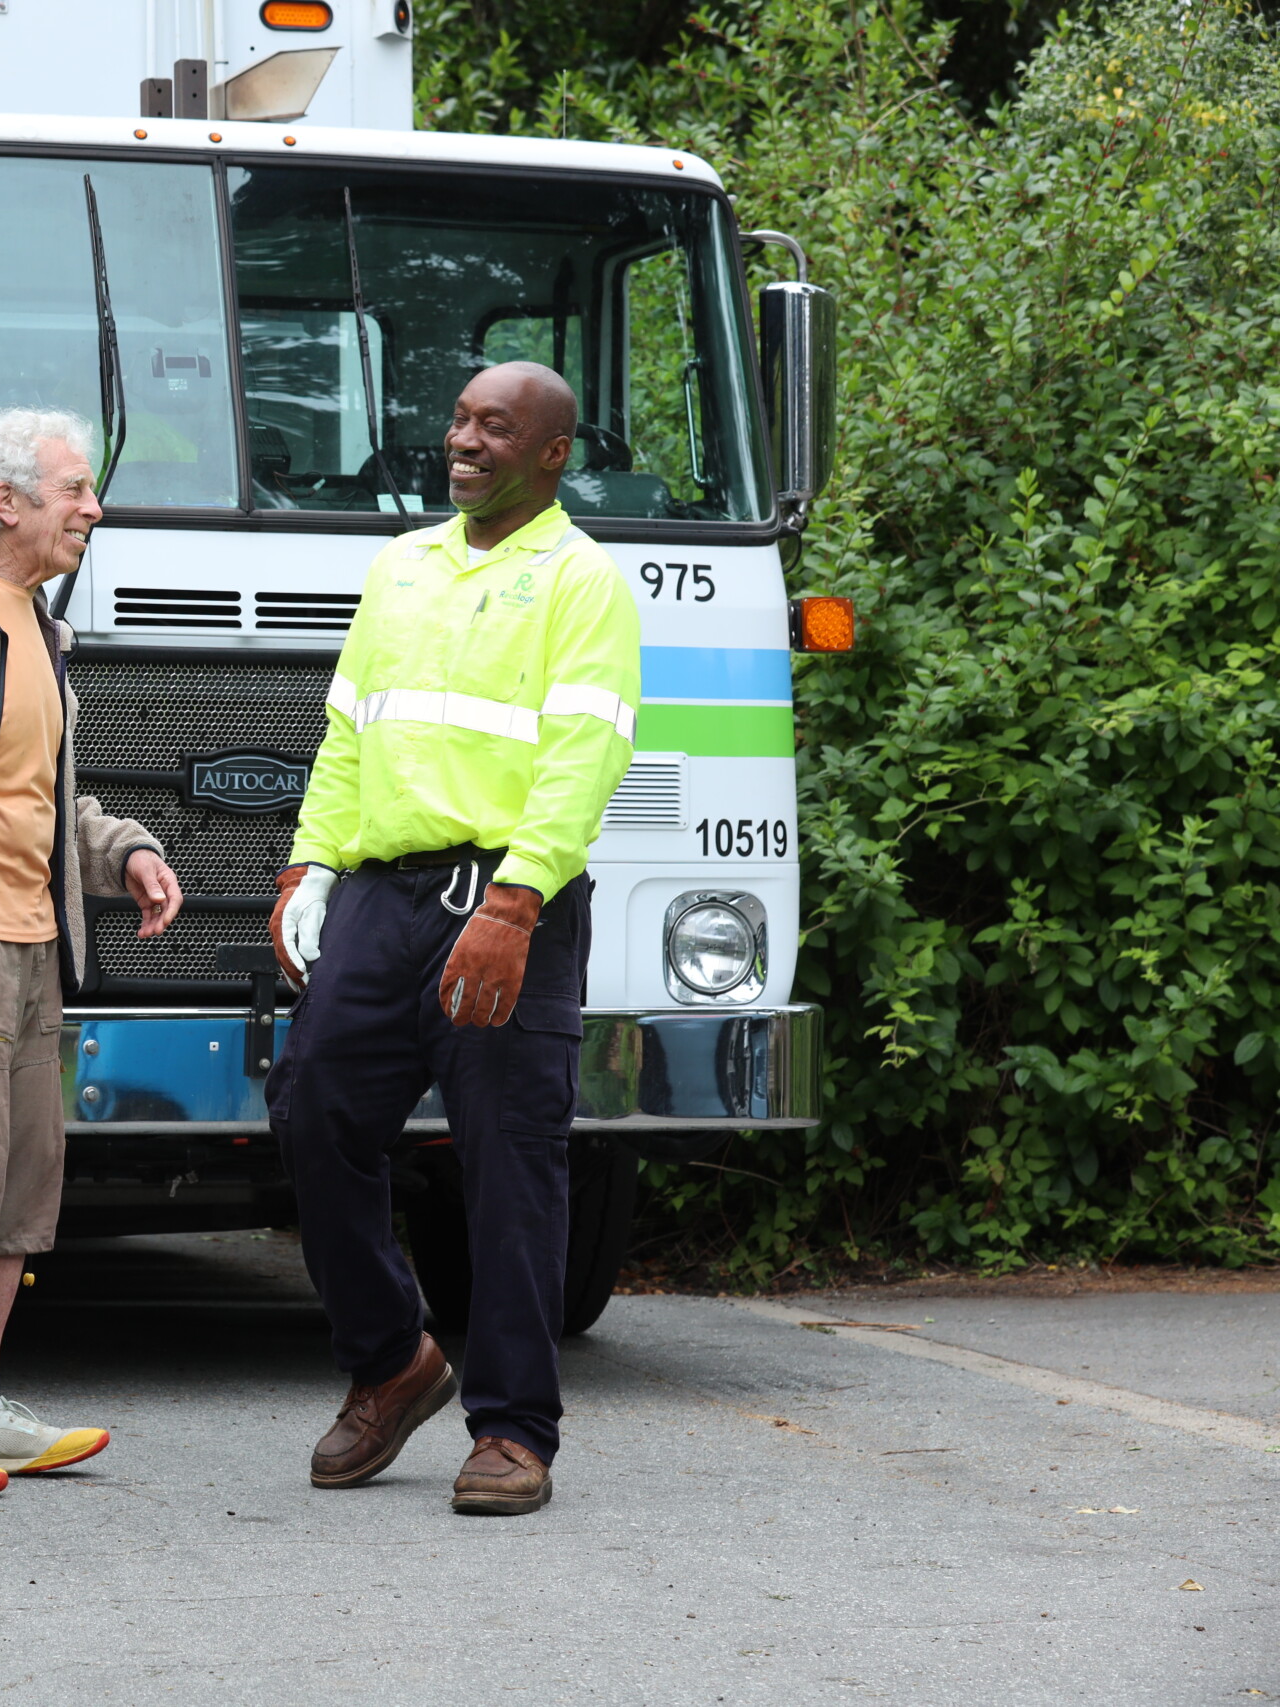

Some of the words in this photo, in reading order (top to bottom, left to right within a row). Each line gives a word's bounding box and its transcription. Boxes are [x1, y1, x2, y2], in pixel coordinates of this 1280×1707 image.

[640, 562, 715, 602] 975
[200, 770, 302, 791] AUTOCAR
[695, 818, 788, 858] 10519
